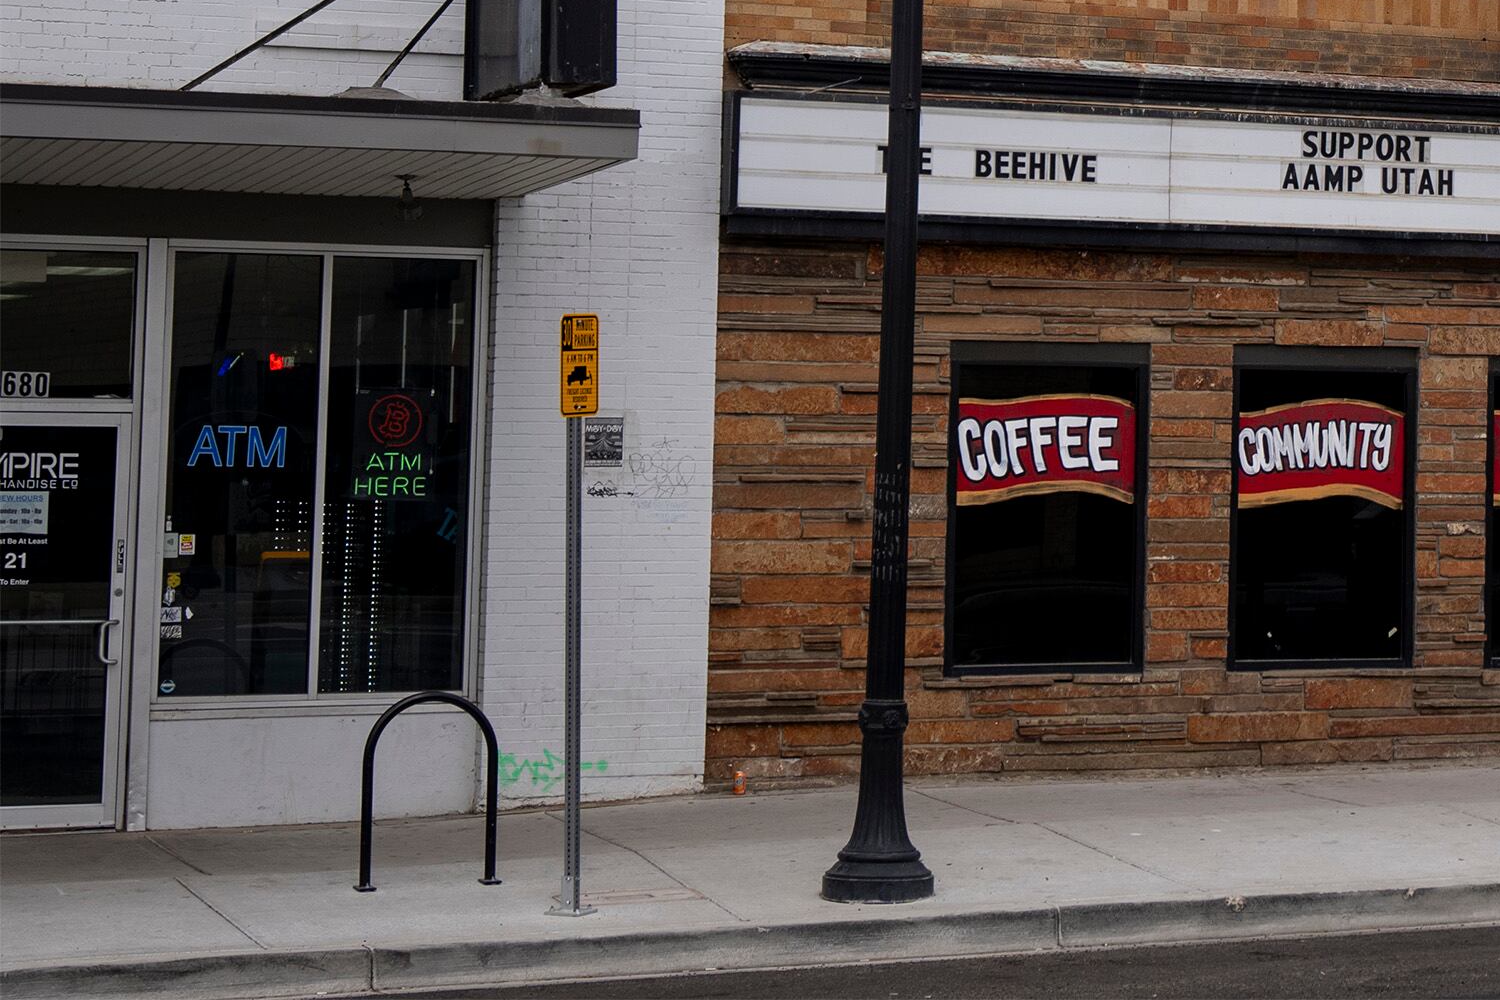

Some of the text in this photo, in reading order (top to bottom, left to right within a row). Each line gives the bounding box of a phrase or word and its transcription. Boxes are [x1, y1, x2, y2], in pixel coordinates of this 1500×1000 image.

[1302, 130, 1430, 163] SUPPORT
[878, 145, 1097, 183] TE BEEHIVE
[1282, 162, 1453, 197] AAMP UTAH
[562, 319, 572, 347] 30
[574, 333, 595, 347] PARKING
[3, 372, 48, 396] 680
[187, 425, 287, 468] ATM
[366, 452, 421, 471] ATM
[957, 415, 1119, 482] COFFEE
[1238, 419, 1393, 475] COMMUNITY
[354, 476, 426, 496] HERE
[4, 552, 27, 569] 21
